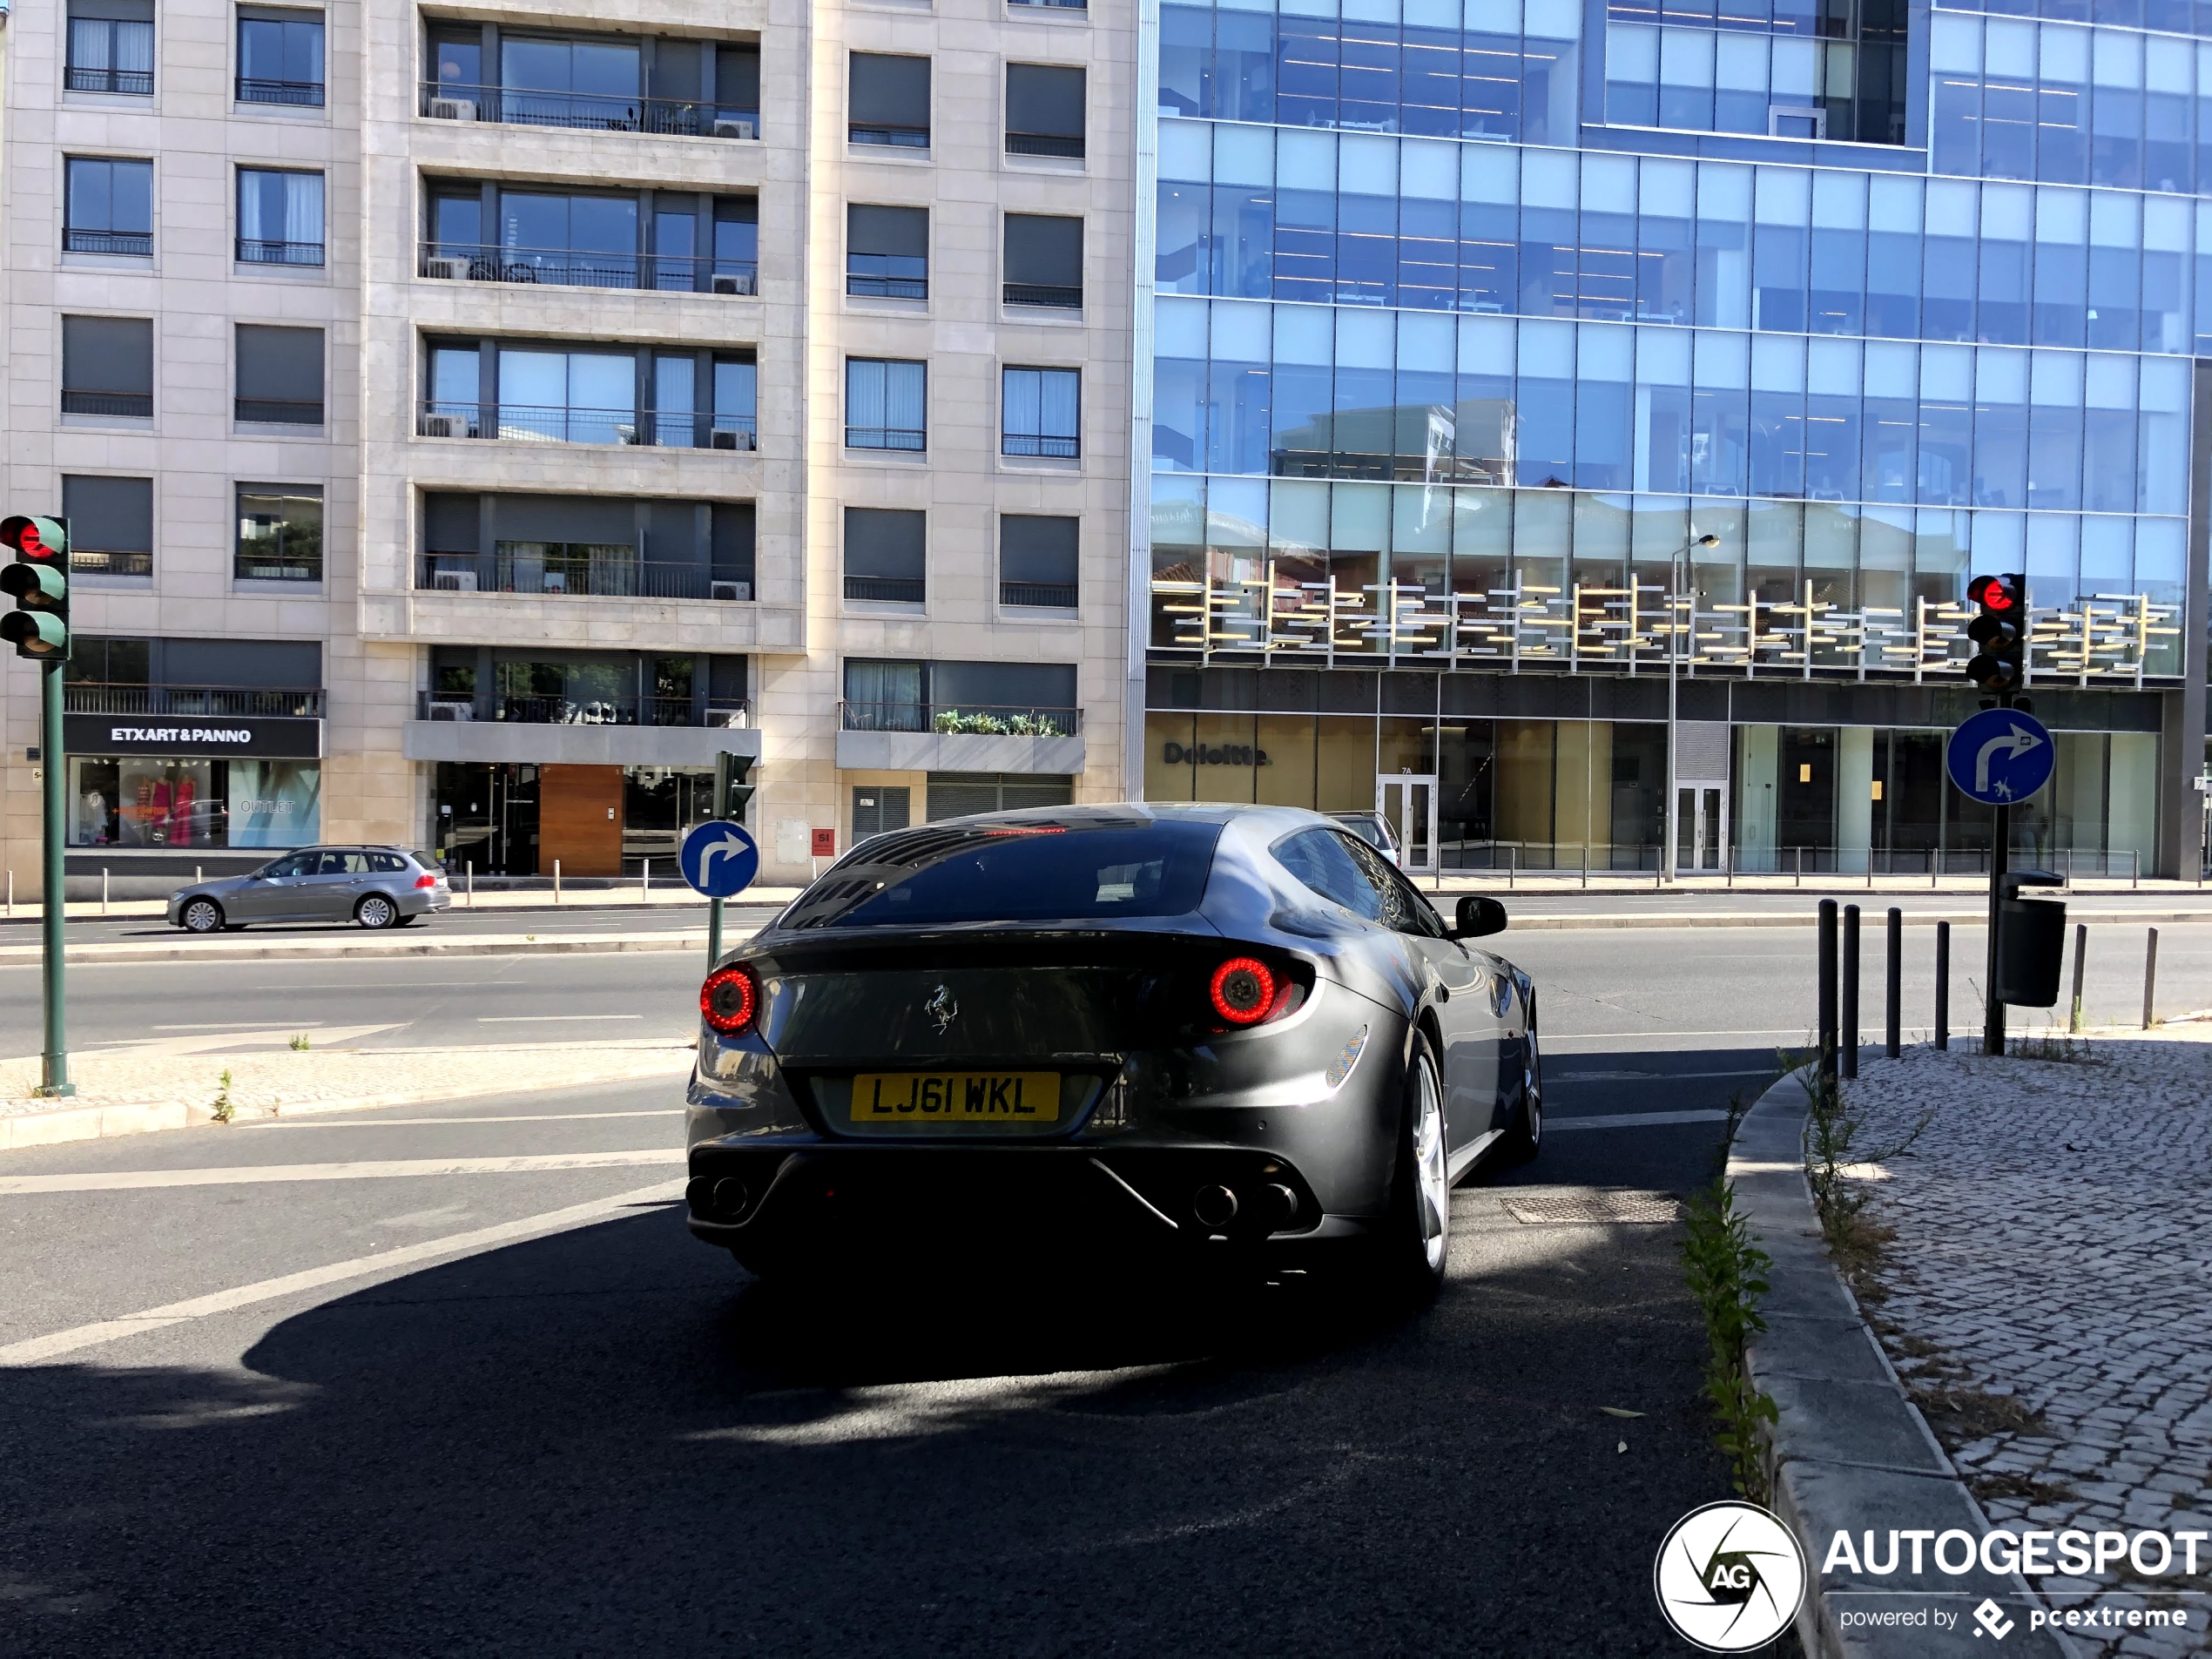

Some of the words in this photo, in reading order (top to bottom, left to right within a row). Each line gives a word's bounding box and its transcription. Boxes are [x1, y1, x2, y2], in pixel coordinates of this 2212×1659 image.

[2197, 779, 2203, 790] 7
[240, 800, 295, 813] OUTLET
[872, 1078, 954, 1113] LJ61
[964, 1077, 1035, 1114] WKL
